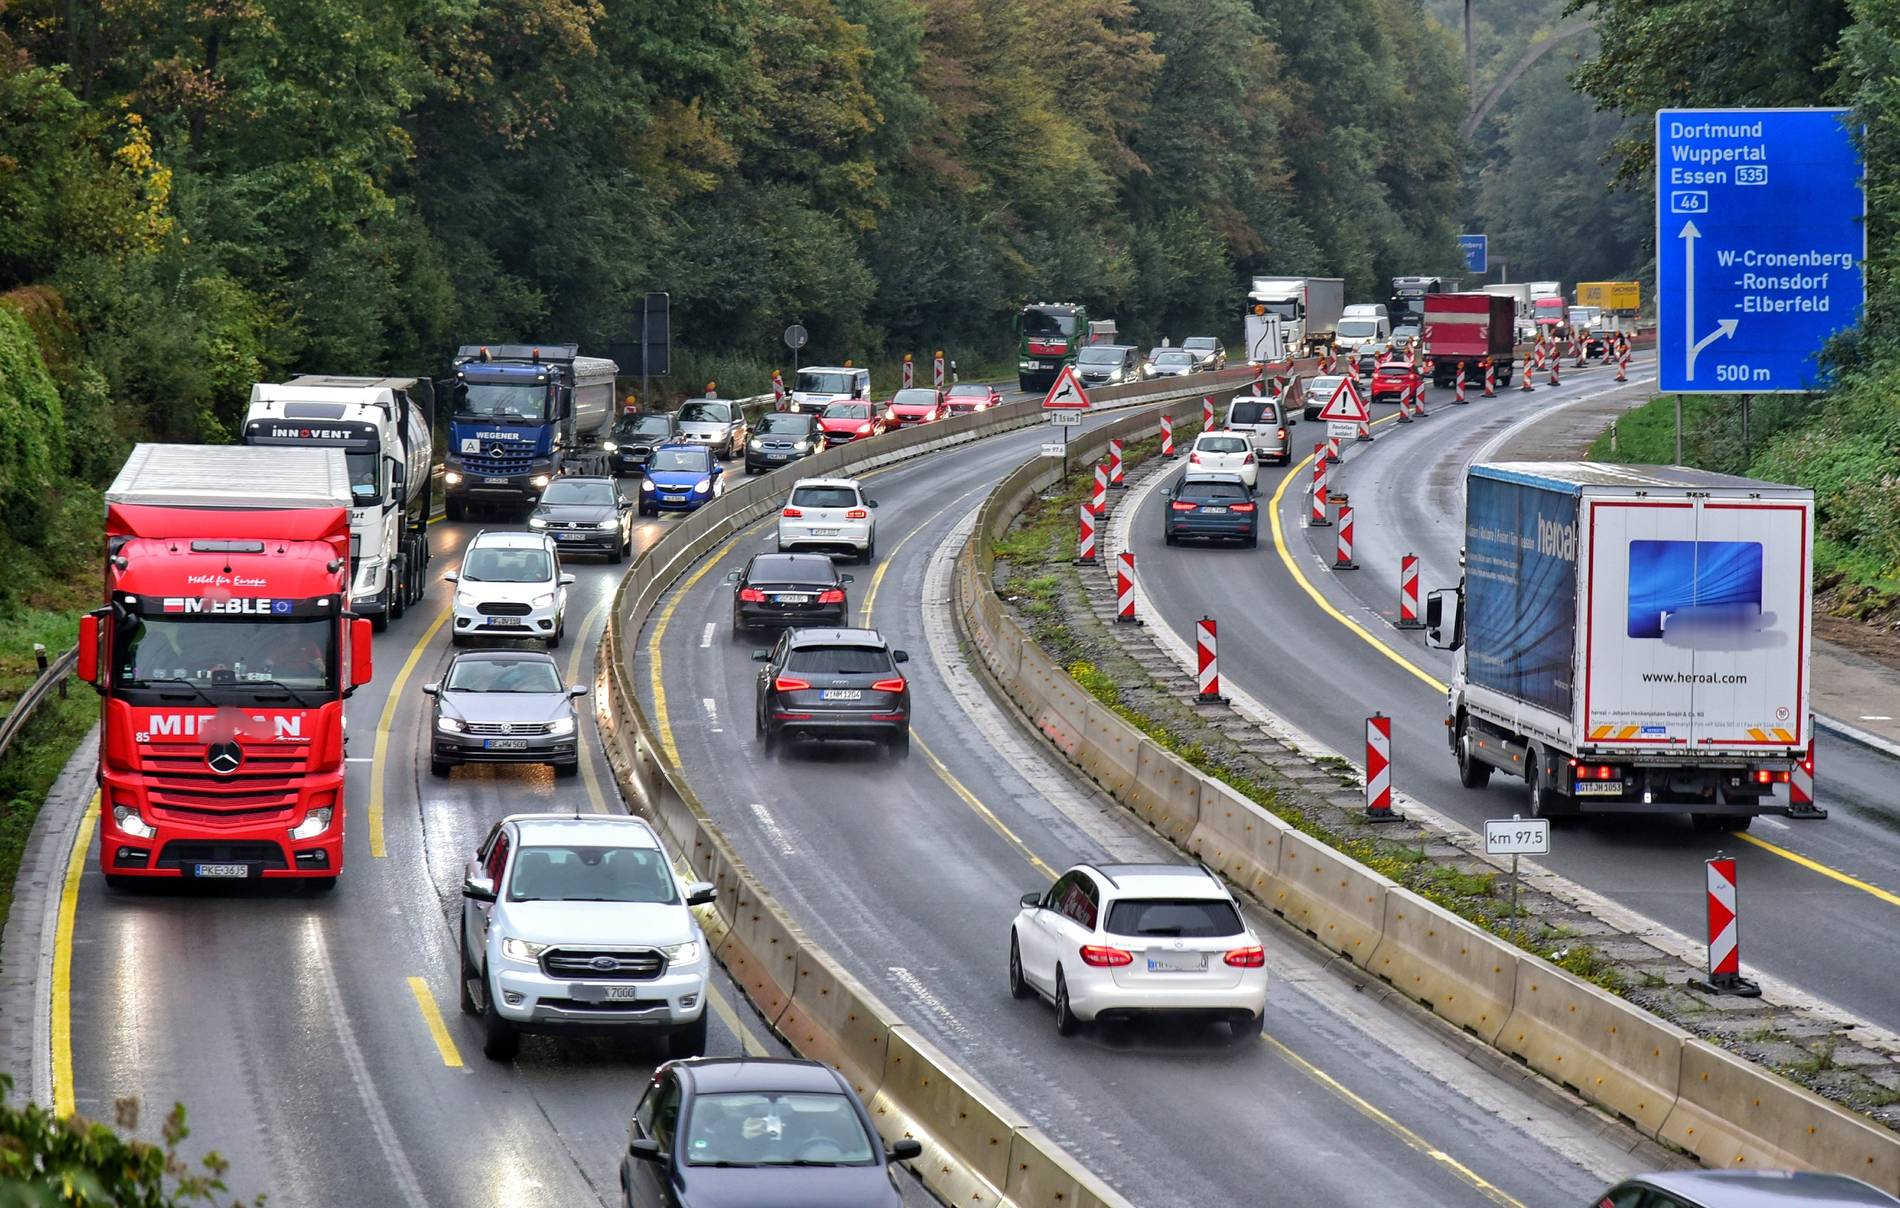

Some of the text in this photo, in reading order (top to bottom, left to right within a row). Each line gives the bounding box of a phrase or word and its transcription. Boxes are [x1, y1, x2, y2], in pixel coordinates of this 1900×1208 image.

[1671, 121, 1762, 138] Dortmund
[1671, 144, 1766, 165] Wuppertal
[1671, 167, 1763, 184] Essen 535
[1681, 196, 1699, 208] 46
[1717, 250, 1852, 269] W-Cronenberg
[1734, 273, 1829, 289] -Ronsdorf
[1734, 296, 1829, 312] -Elberfeld
[1717, 365, 1770, 381] 500 m
[476, 431, 519, 440] WEGENER
[465, 442, 476, 451] A
[1537, 511, 1576, 562] heroal
[188, 575, 267, 586] Möbel für Europa
[185, 597, 271, 614] MEBLE
[1642, 672, 1747, 684] www.heroal.com
[135, 732, 150, 742] 85
[1489, 831, 1543, 844] km 97.5
